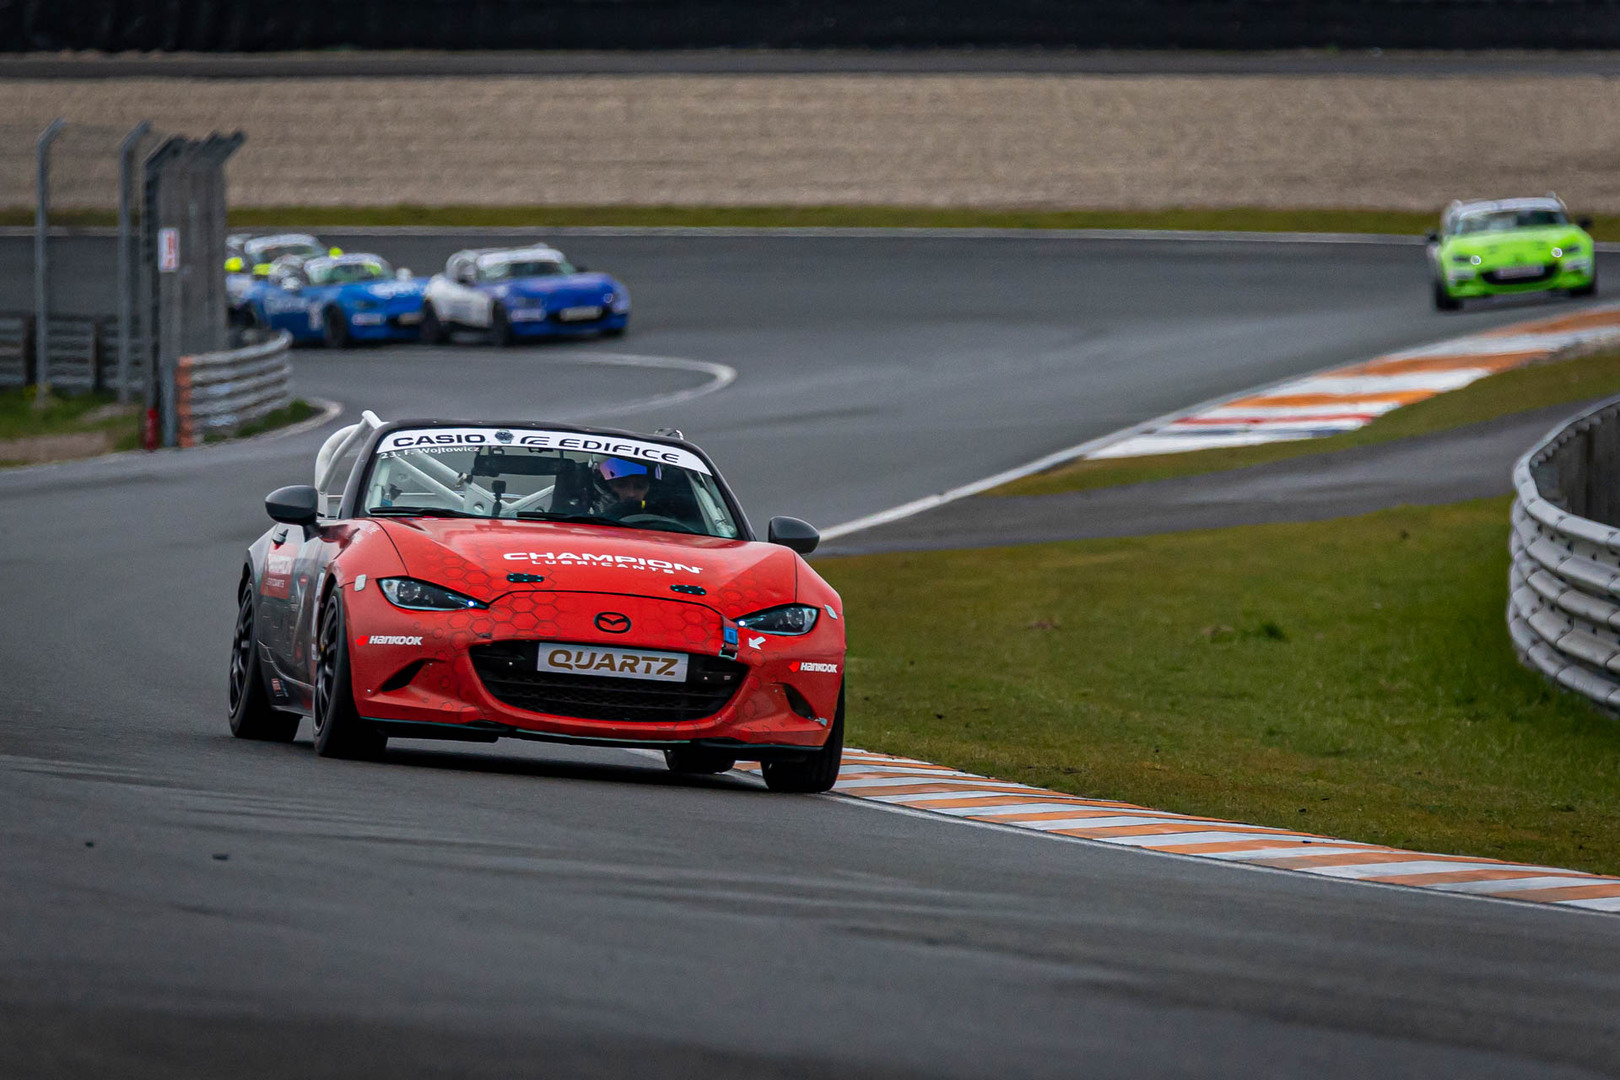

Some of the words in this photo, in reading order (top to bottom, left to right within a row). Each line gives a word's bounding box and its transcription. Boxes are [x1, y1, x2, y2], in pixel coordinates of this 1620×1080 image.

[381, 451, 401, 459] 23.
[416, 446, 480, 454] Wojtowicz
[393, 434, 486, 447] CASIO
[559, 438, 679, 463] EDIFICE
[503, 552, 702, 574] CHAMPION
[531, 560, 675, 574] LUBRICANTS
[547, 649, 678, 676] QUARTZ
